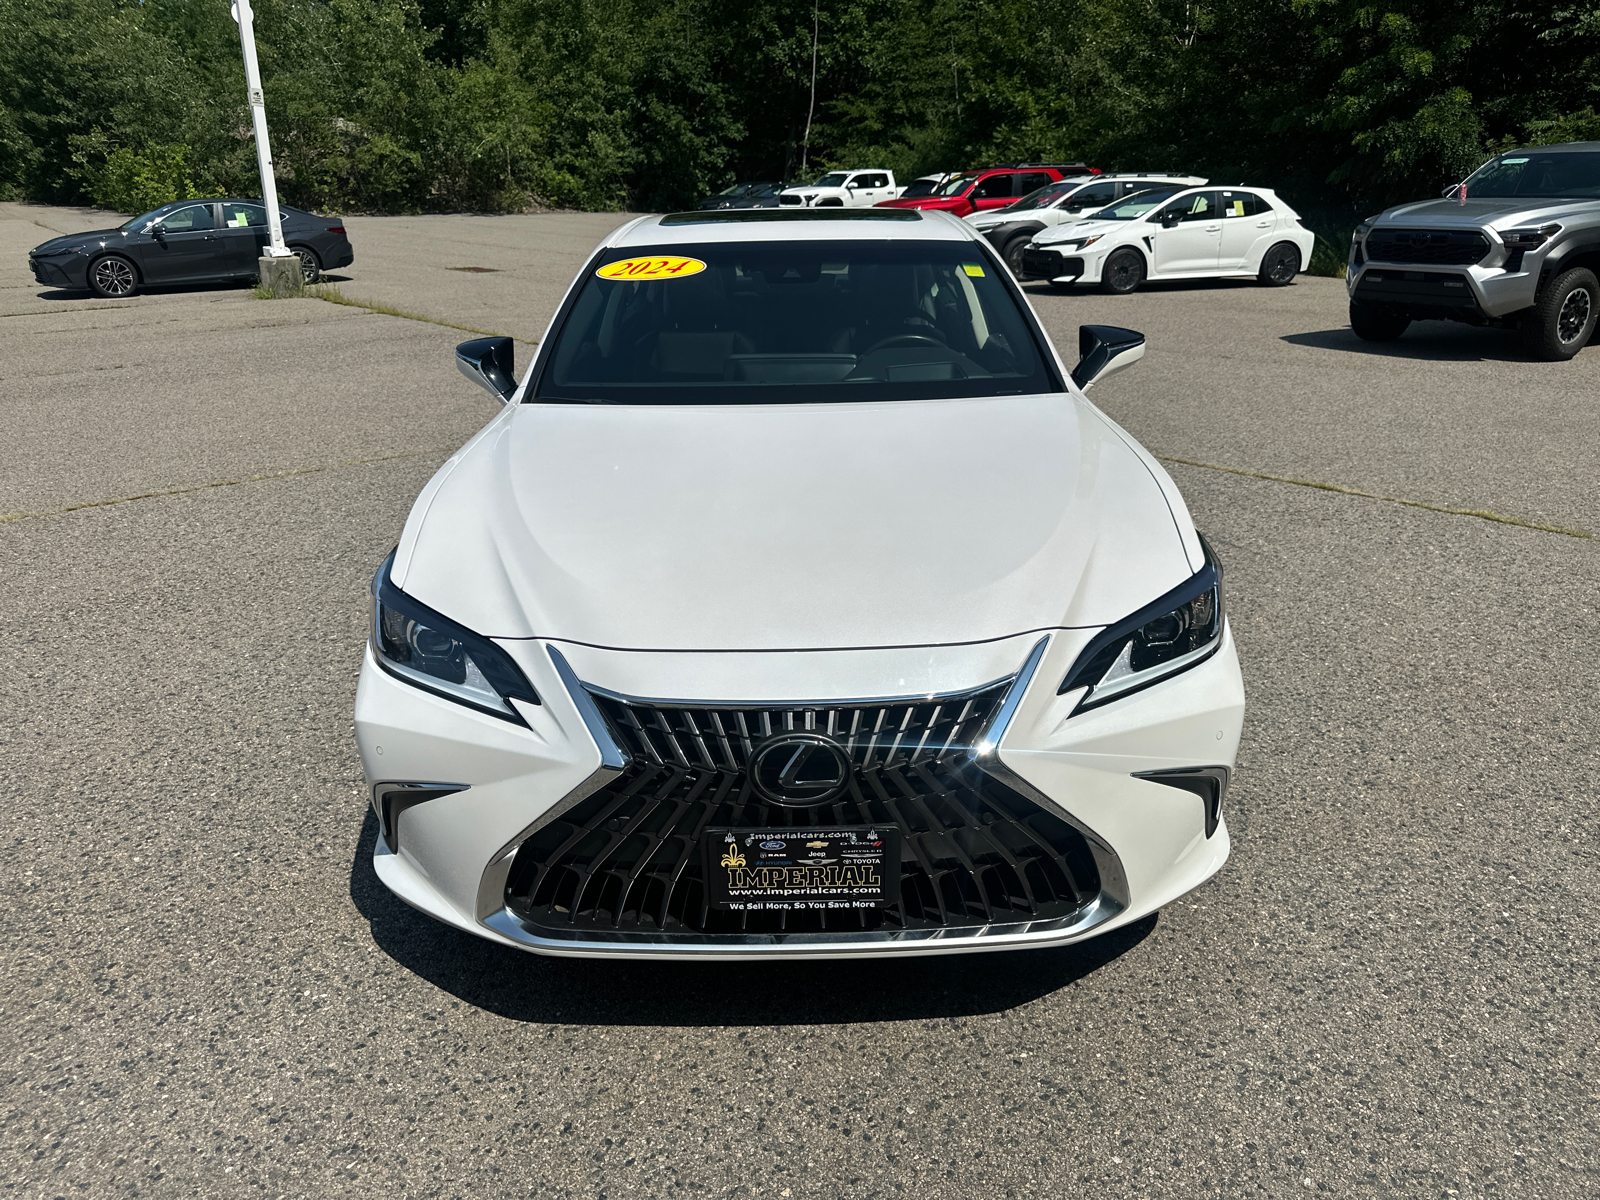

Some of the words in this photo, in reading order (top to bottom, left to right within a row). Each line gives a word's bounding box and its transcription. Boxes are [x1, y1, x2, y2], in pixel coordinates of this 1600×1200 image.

[609, 261, 691, 276] 2024
[750, 832, 854, 840] Imperialcars.com
[728, 866, 880, 888] IMPERIAL
[729, 887, 880, 896] www.imperialcars.com
